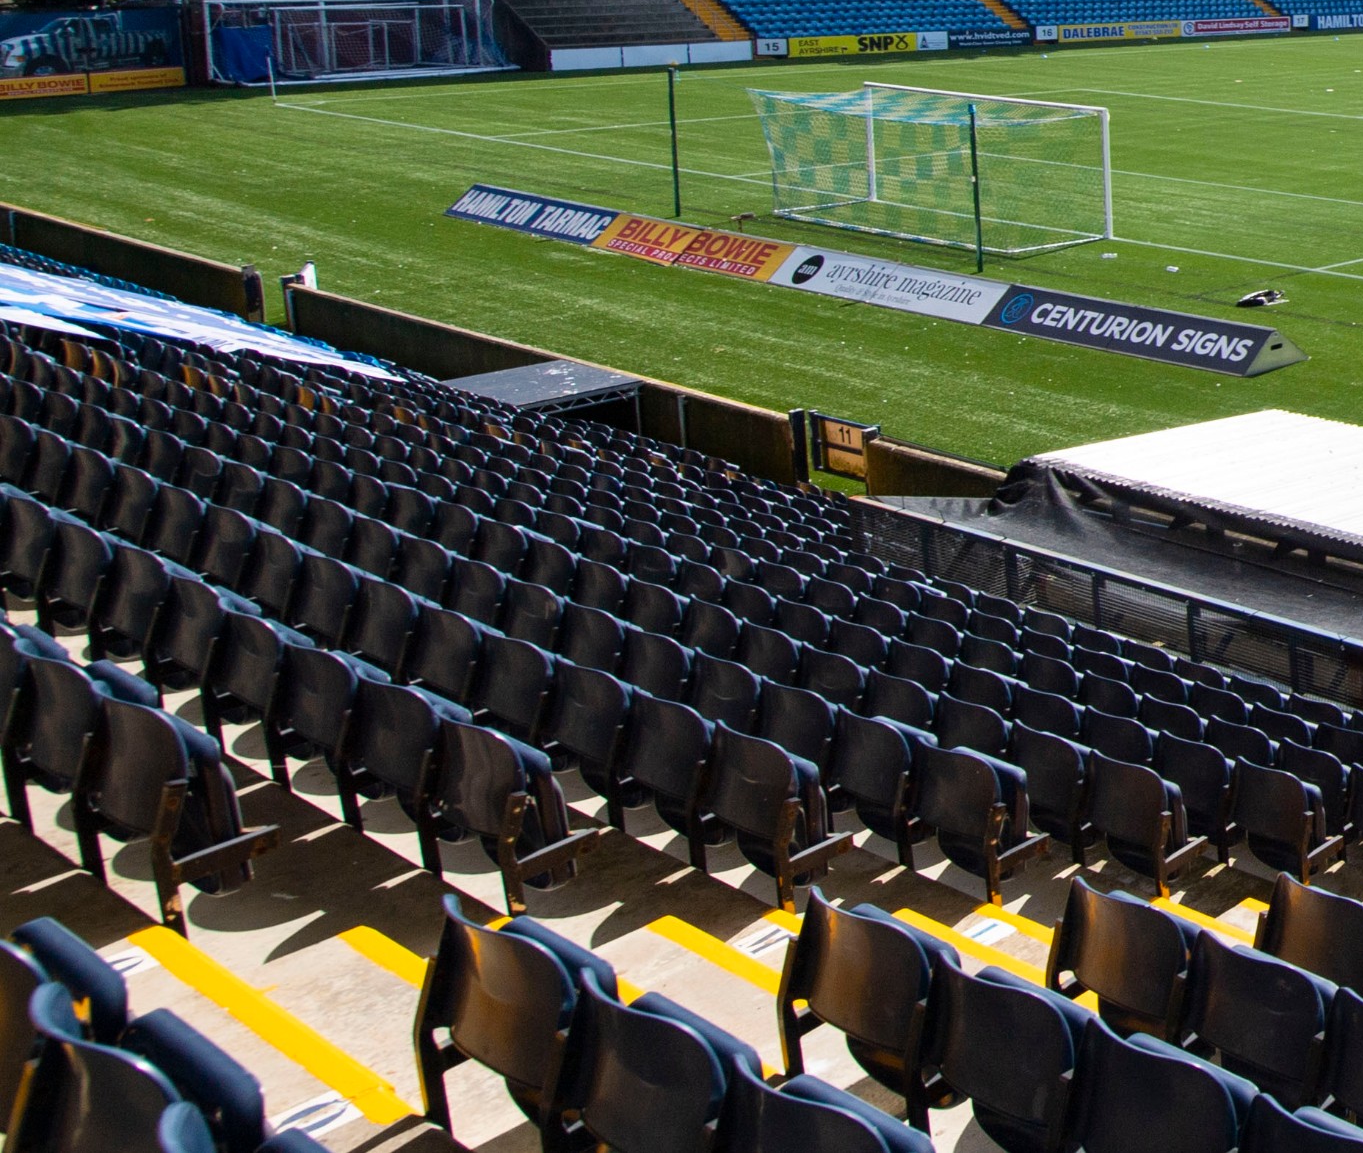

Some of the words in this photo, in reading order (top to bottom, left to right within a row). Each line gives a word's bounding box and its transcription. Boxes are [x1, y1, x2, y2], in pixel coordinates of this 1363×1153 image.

[1198, 21, 1218, 30] David
[1218, 20, 1244, 31] Lindsay
[1244, 19, 1259, 28] Self
[1260, 19, 1287, 29] Storage
[950, 30, 1030, 42] www.hvidtved.com
[1042, 29, 1053, 37] 16
[1063, 26, 1125, 40] DALEBRAE
[765, 42, 779, 52] 15
[798, 47, 839, 55] AYRSHIRE
[858, 35, 894, 53] SNP
[37, 78, 85, 90] BOWIE
[452, 190, 541, 226] HAMILTON
[539, 206, 612, 240] TARMAC
[617, 219, 692, 249] BILLY
[689, 232, 780, 265] BOWIE
[607, 239, 649, 257] SPECIAL
[709, 258, 755, 275] LIMITED
[799, 263, 819, 275] am
[826, 264, 897, 289] ayrshire
[897, 277, 982, 306] magazine
[1031, 301, 1175, 346] CENTURION
[1170, 327, 1254, 362] SIGNS
[839, 426, 852, 444] 11
